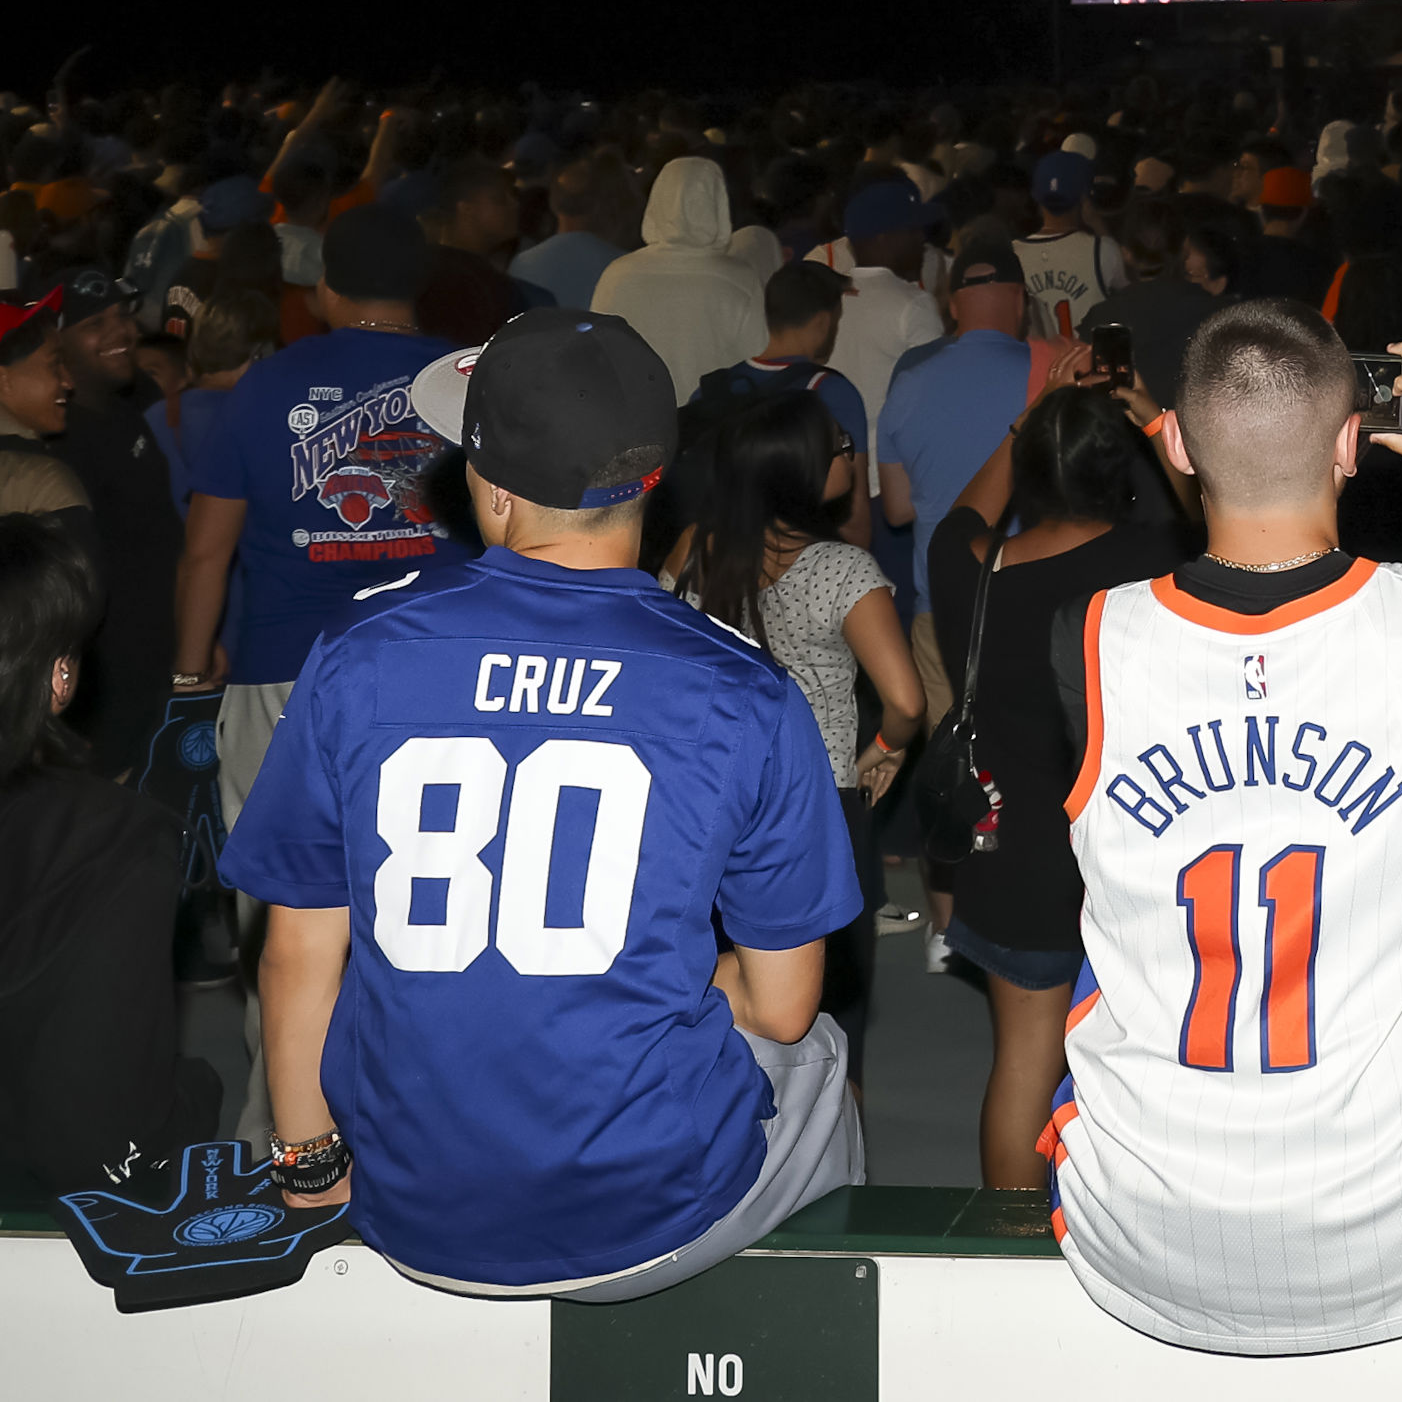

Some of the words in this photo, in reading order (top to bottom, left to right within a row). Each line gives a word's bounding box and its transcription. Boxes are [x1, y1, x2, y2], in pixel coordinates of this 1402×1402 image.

[1027, 270, 1088, 300] UNSON
[308, 387, 343, 401] NYC
[291, 407, 364, 502] NEW
[308, 536, 437, 564] CHAMPIONS
[474, 653, 624, 717] CRUZ
[373, 736, 654, 977] 80
[1177, 843, 1327, 1073] 11
[687, 1353, 743, 1397] NO
